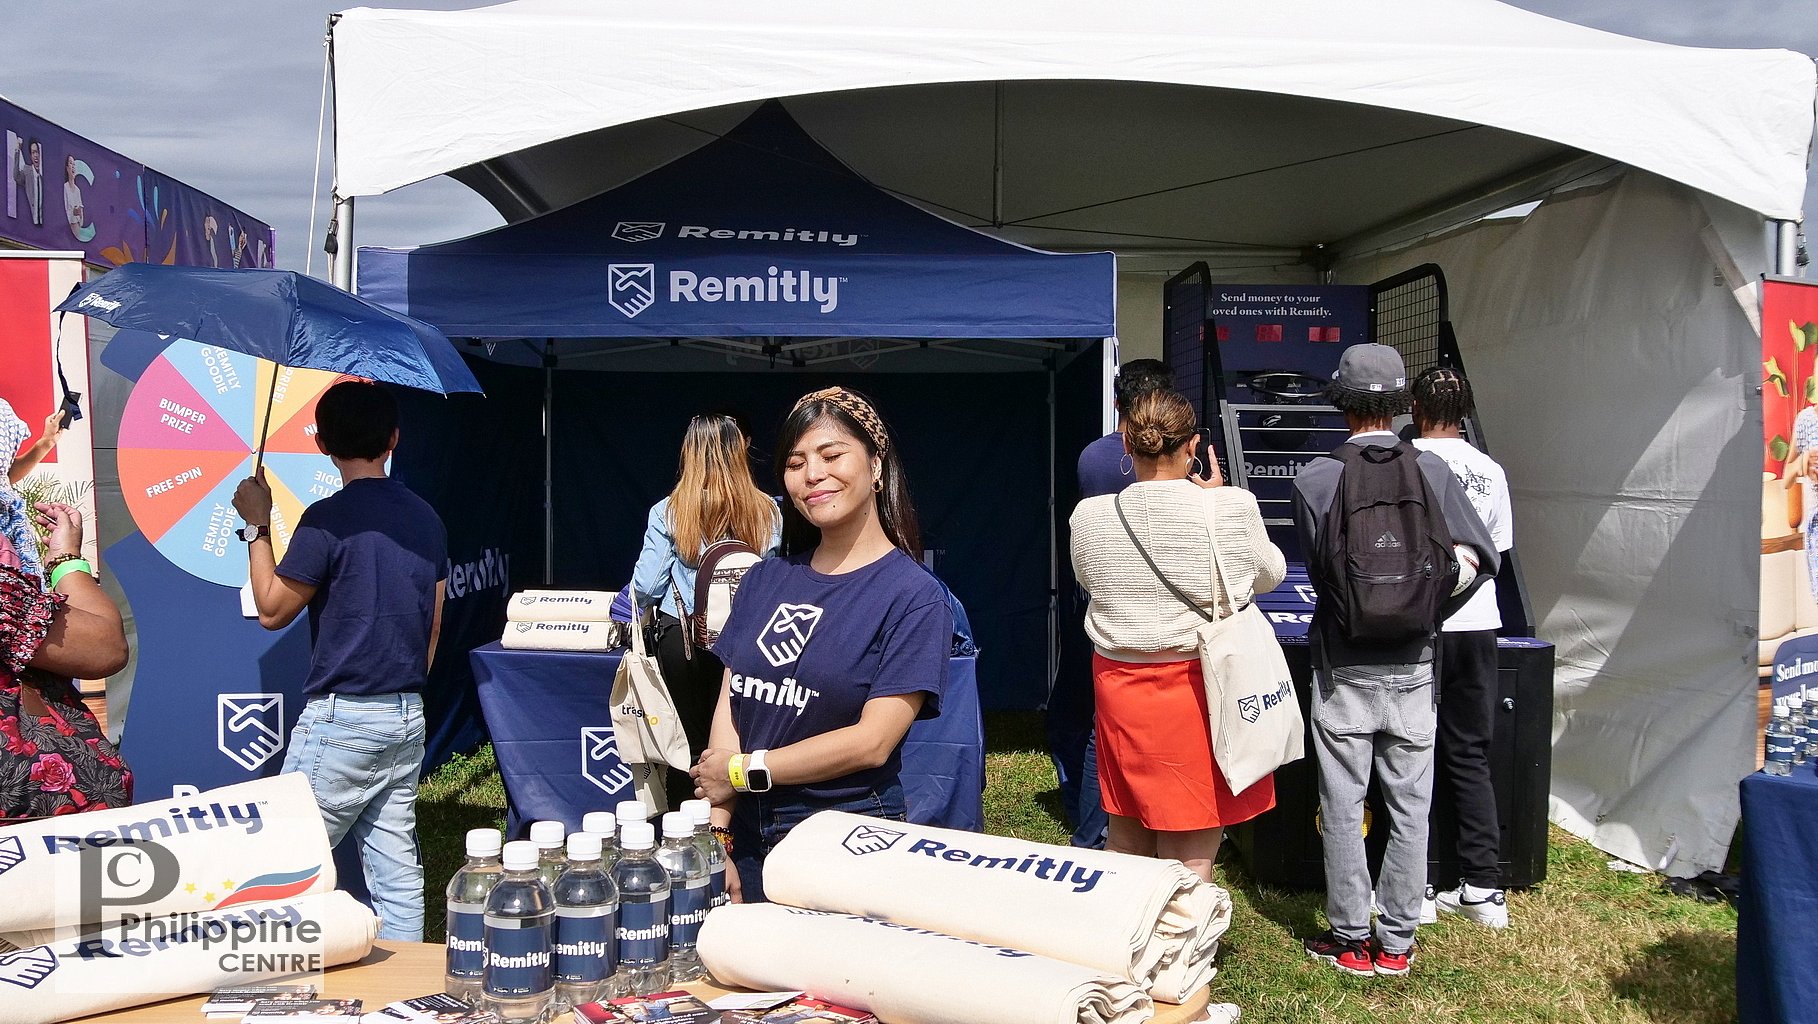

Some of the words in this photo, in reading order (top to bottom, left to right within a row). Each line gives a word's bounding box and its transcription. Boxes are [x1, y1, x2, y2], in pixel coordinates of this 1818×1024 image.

[1220, 292, 1246, 302] Send
[1248, 294, 1283, 305] money
[1284, 294, 1295, 303] to
[1296, 295, 1321, 305] your
[1212, 306, 1238, 316] oved
[1239, 308, 1263, 316] ones
[1264, 306, 1288, 316] with
[1289, 306, 1332, 319] Remitly.
[201, 346, 229, 395] GOODIE
[272, 367, 295, 404] PRISE!
[158, 397, 207, 425] BUMPER
[160, 413, 194, 435] PRIZE
[1243, 460, 1309, 476] Remit
[145, 475, 175, 498] FREE
[174, 466, 203, 487] SPIN
[313, 470, 344, 488] ODIE
[202, 502, 226, 552] REMITLY
[214, 507, 237, 558] GOODIE
[539, 596, 594, 605] Remitly
[535, 623, 590, 634] Remitly
[1776, 657, 1802, 682] Send
[618, 924, 669, 941] Remitly
[450, 935, 485, 952] Remi
[490, 951, 551, 969] Remitly
